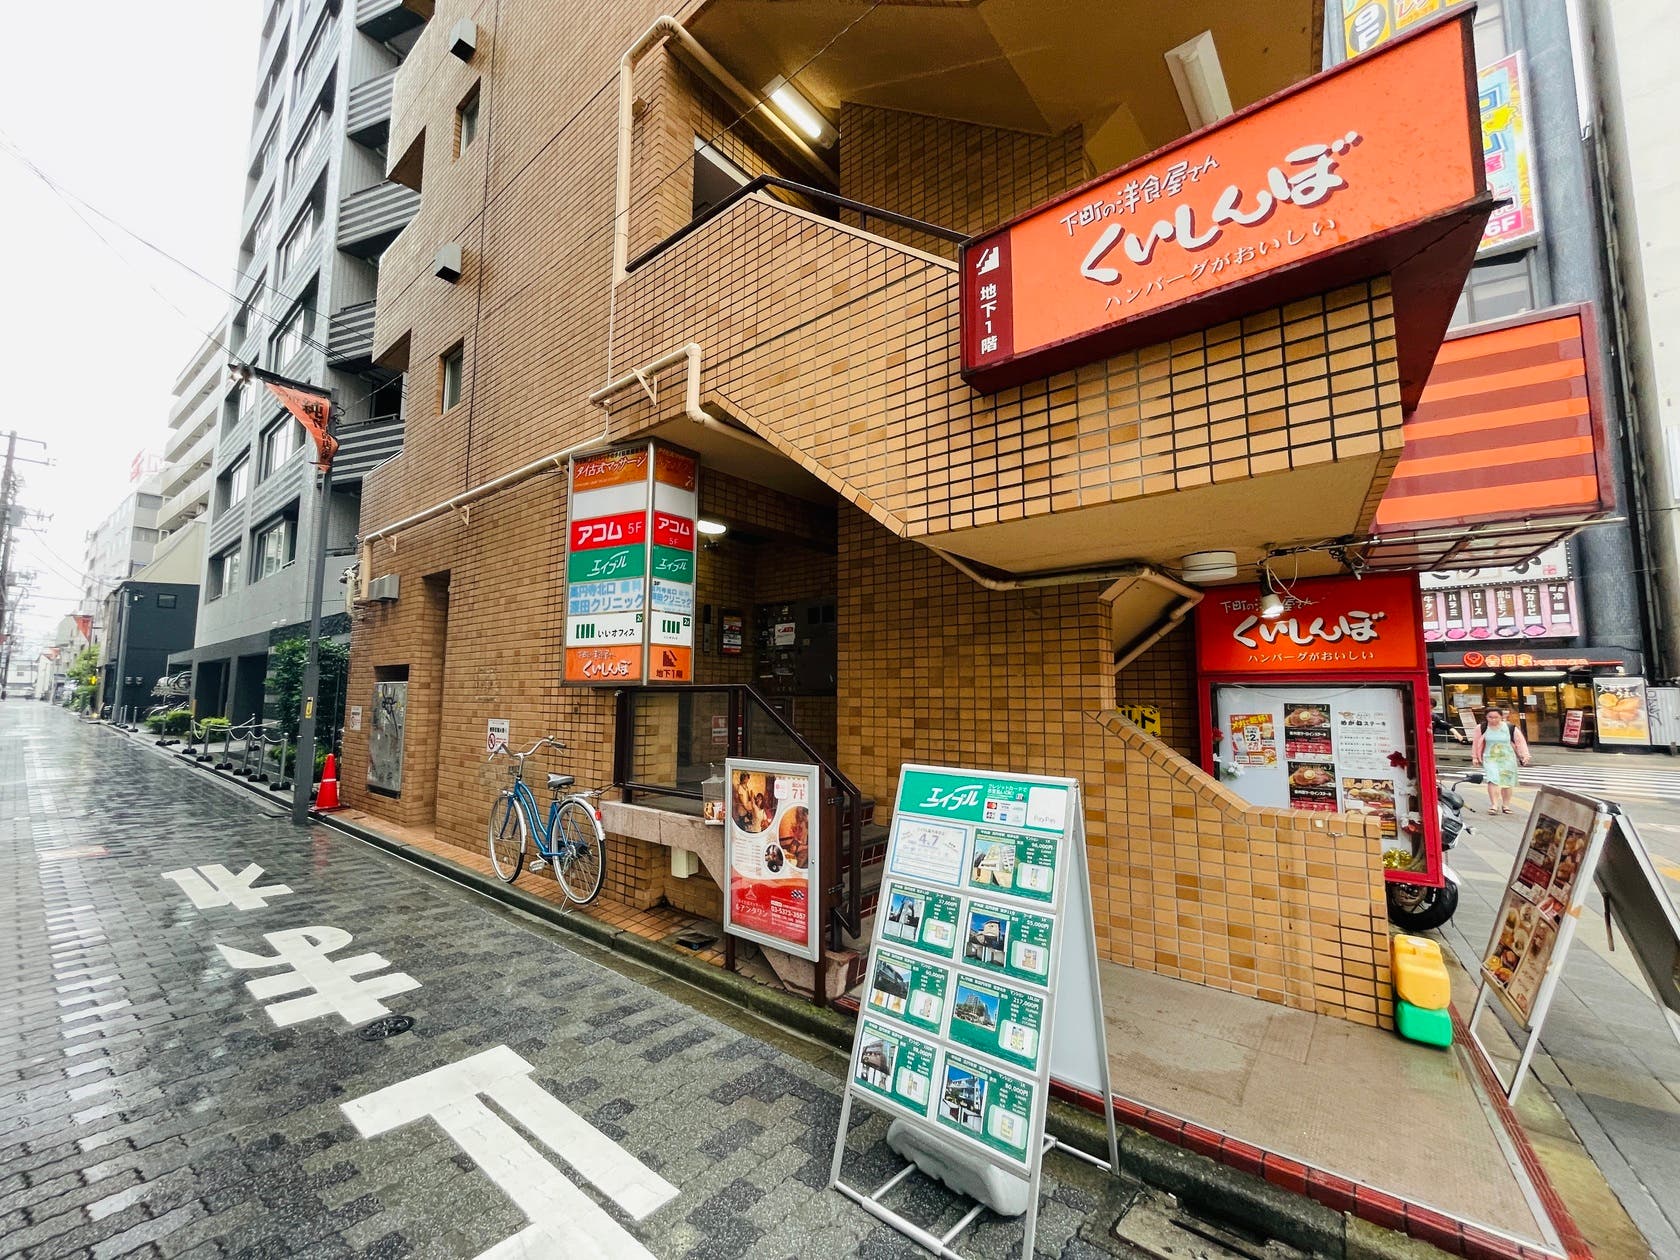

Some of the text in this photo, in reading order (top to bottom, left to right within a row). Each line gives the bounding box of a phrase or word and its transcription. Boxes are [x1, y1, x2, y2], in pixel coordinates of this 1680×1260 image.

[1060, 155, 1219, 237] 下町の洋食屋さん
[1080, 131, 1363, 284] くいしんぼ
[1105, 219, 1337, 311] ハンバーグがおいしい
[980, 284, 998, 355] 地下1階
[578, 521, 643, 545] アコム 5F
[658, 518, 690, 536] アコム
[587, 551, 630, 577] エイブル
[655, 558, 689, 572] エイブル
[1448, 593, 1458, 617] ハラミ
[1473, 592, 1483, 615] ロース
[597, 628, 636, 638] いいオフィス
[1233, 610, 1387, 647] くいしんぼ
[583, 660, 633, 678] くいしんぼ
[1248, 651, 1375, 663] ハンバーグがおいしい
[919, 784, 984, 811] エイブル
